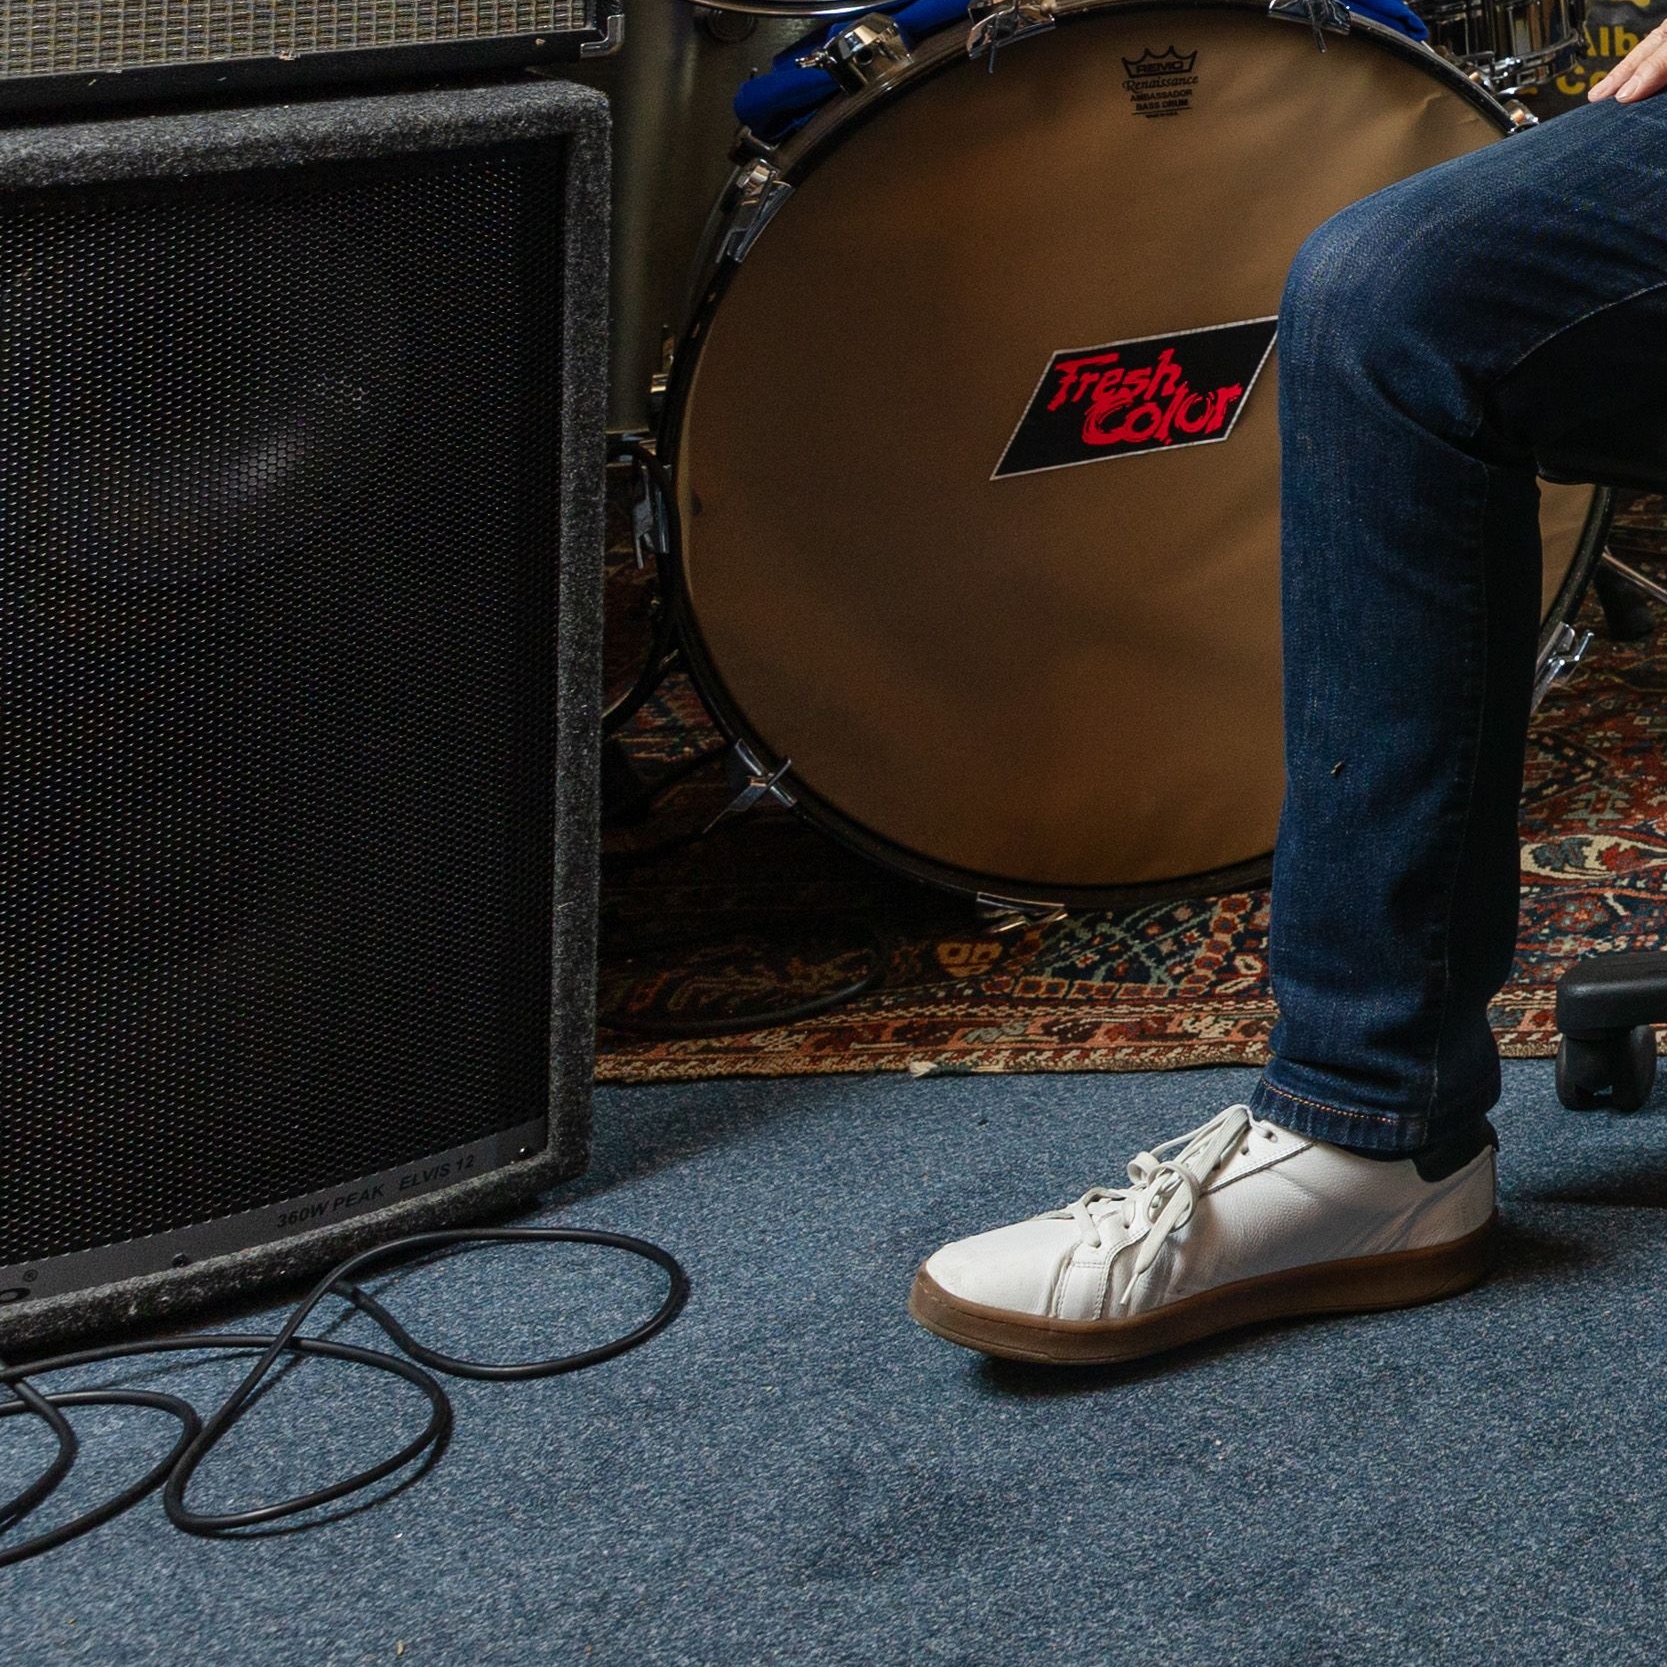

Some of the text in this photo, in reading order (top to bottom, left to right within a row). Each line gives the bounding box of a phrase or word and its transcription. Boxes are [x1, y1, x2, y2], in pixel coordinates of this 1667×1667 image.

[1136, 61, 1184, 74] REMO
[1122, 76, 1199, 94] Renaissance
[1130, 89, 1193, 102] AMBASSADOR
[1136, 99, 1189, 111] BASS DRUM
[1047, 348, 1187, 411] Fresh
[1082, 381, 1243, 446] Color
[276, 1154, 475, 1230] 360W PEAK ELVIS 12
